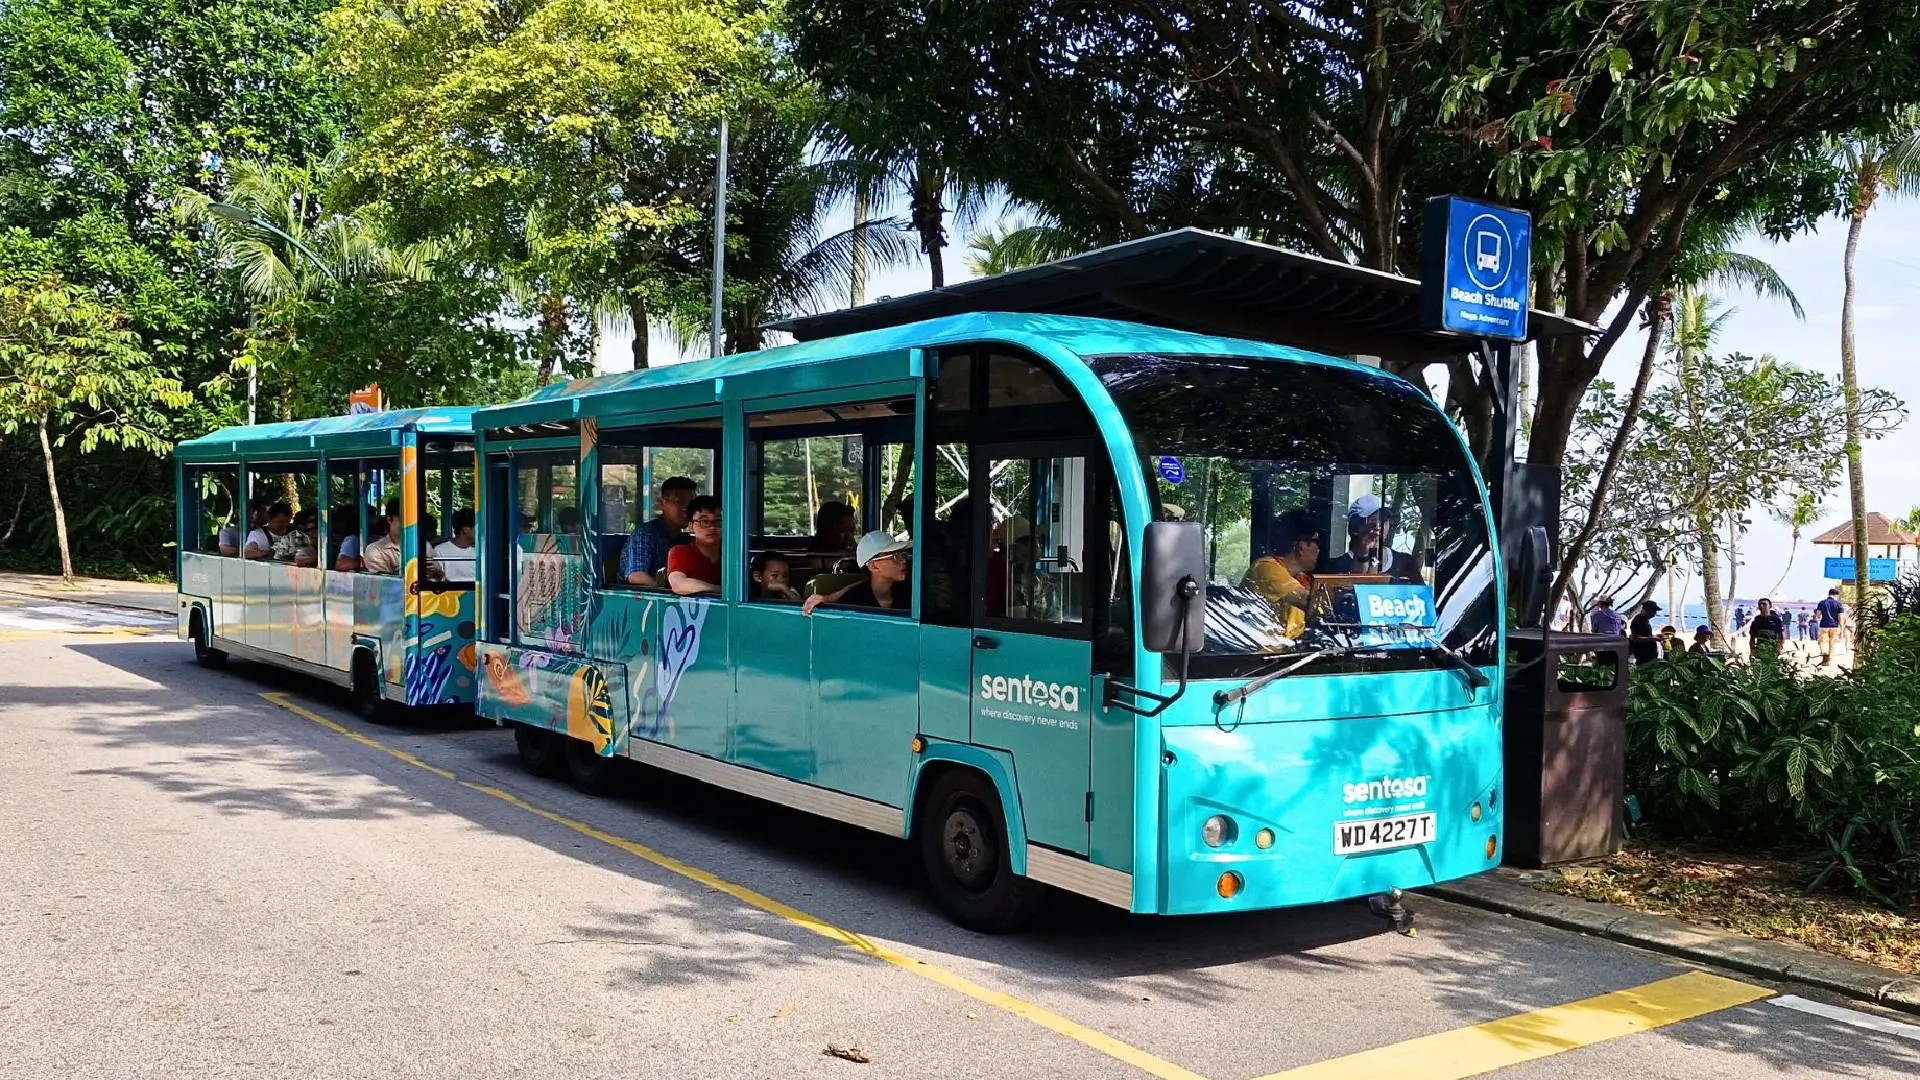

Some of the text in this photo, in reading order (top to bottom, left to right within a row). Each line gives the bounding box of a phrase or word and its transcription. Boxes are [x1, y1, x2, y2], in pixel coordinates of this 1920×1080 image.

[1450, 287, 1520, 311] Beach Shuttle
[1368, 593, 1426, 617] Beach
[981, 674, 1079, 712] sentosa
[981, 707, 1078, 730] where discovery never ends
[1343, 774, 1427, 803] sentosa
[1341, 816, 1430, 848] WD4227T
